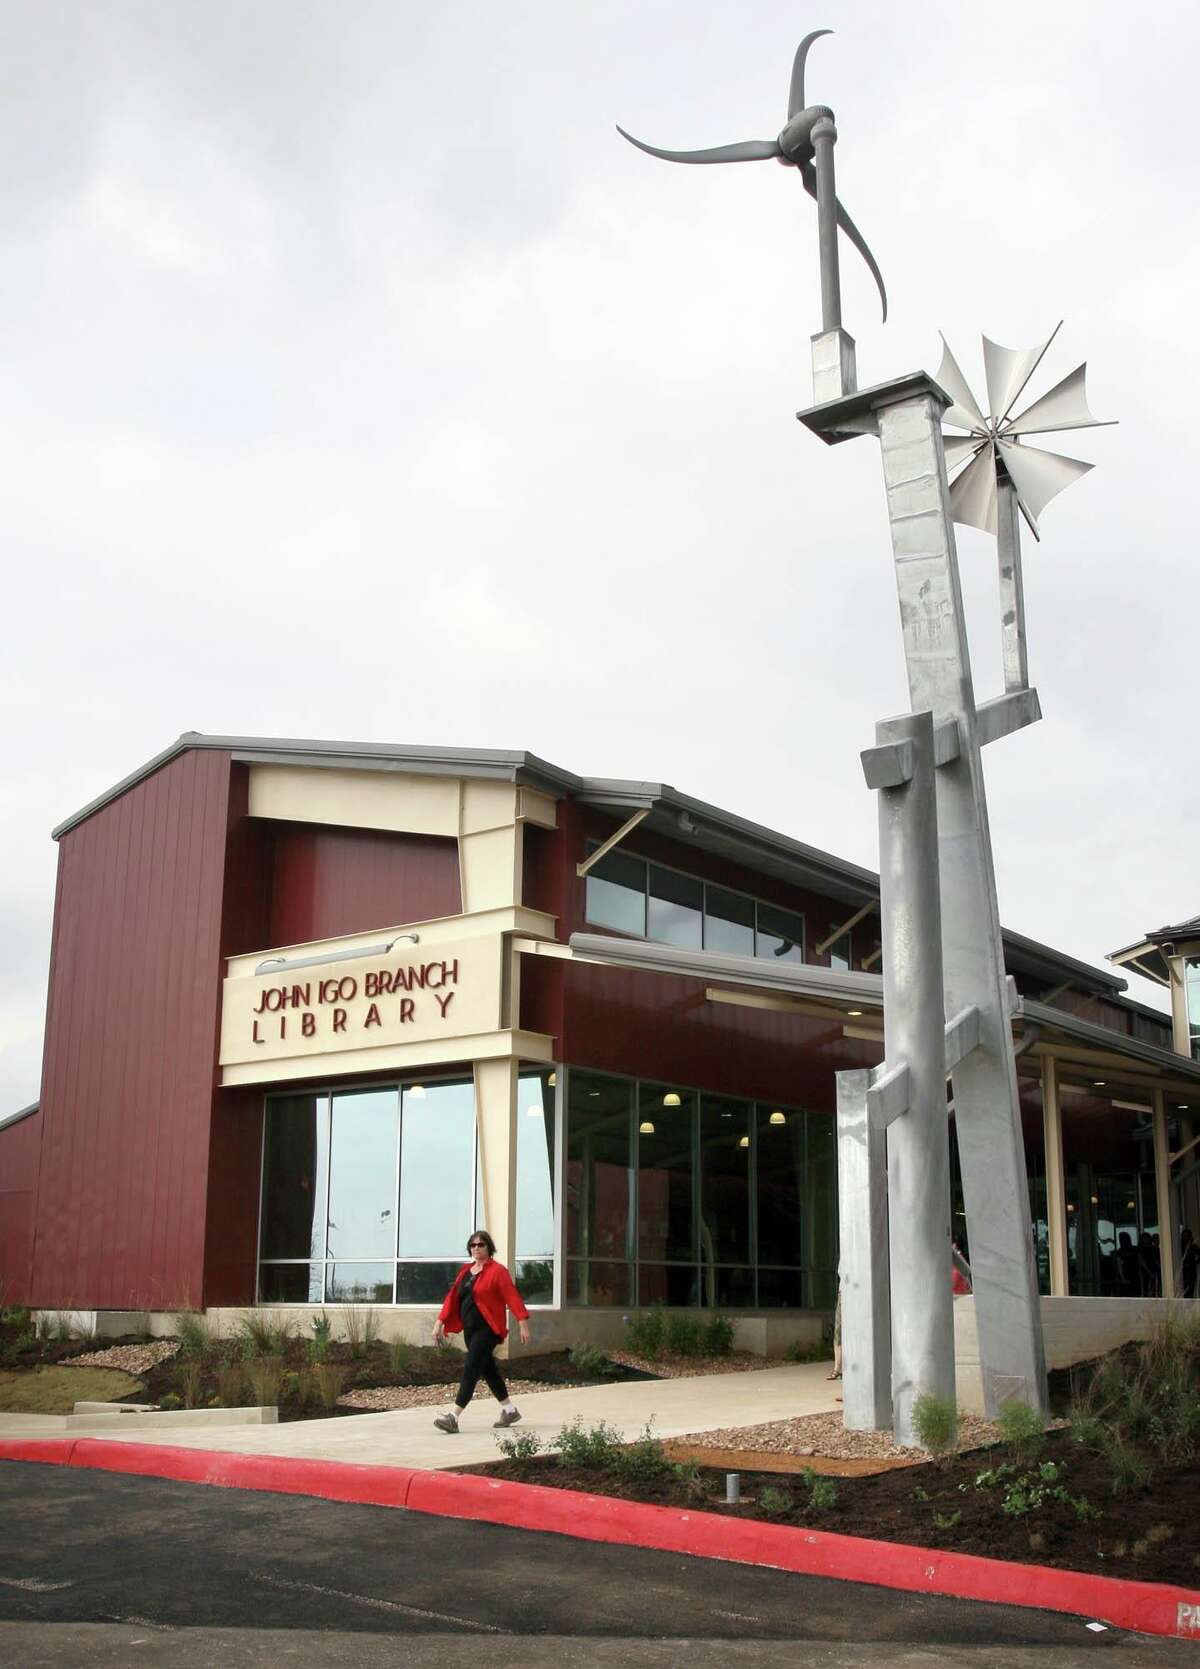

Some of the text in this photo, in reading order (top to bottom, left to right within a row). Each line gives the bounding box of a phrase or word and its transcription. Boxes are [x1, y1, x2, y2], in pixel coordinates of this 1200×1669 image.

[253, 959, 459, 1014] JOHN IGO BRANCH
[252, 991, 455, 1045] LIBRARY
